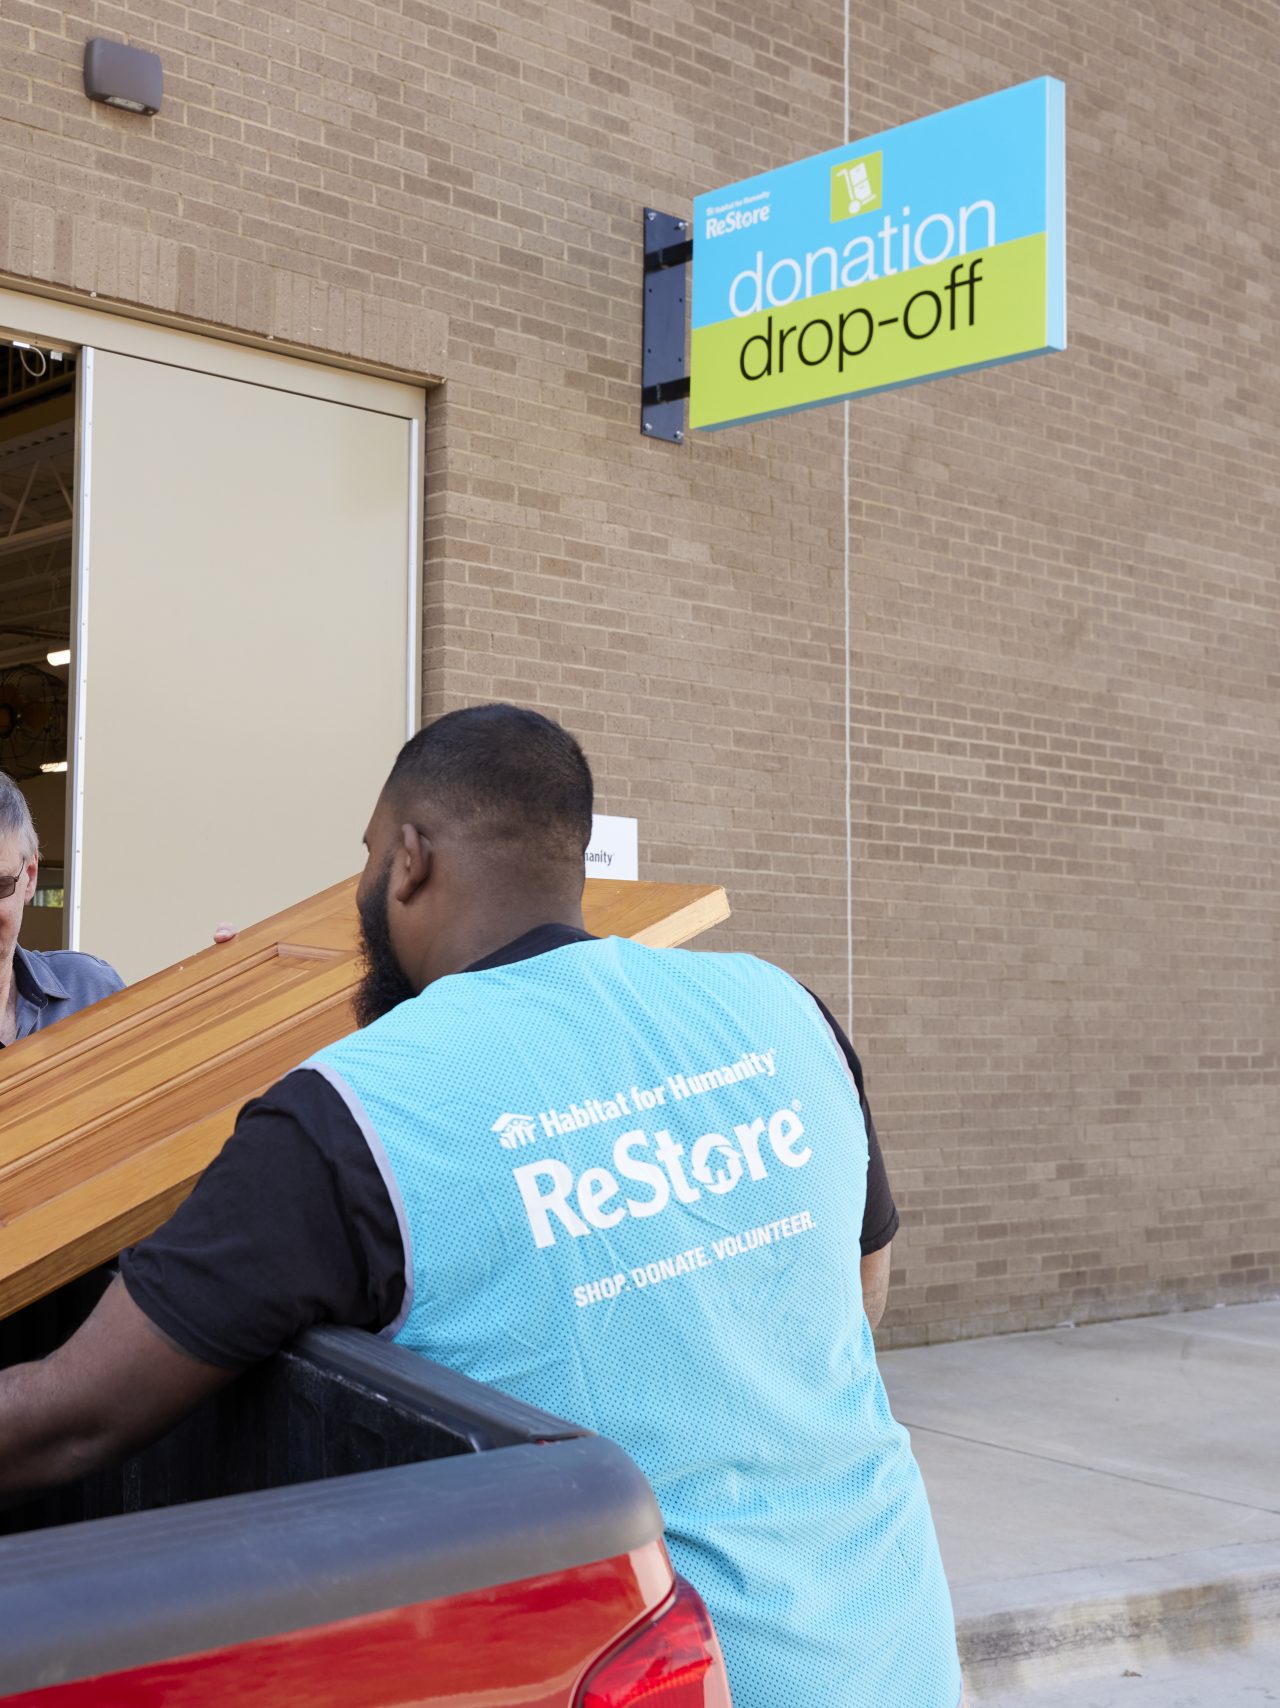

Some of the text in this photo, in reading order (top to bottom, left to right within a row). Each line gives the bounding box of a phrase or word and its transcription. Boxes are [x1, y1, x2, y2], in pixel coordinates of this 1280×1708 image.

[706, 206, 771, 240] ReStore
[729, 200, 996, 318] donation
[739, 258, 983, 381] drop-off
[539, 1052, 776, 1137] Habitat for Humanity
[512, 1109, 813, 1249] ReStore
[573, 1211, 817, 1307] SHOP. DONATE. VOLUNTEER.
